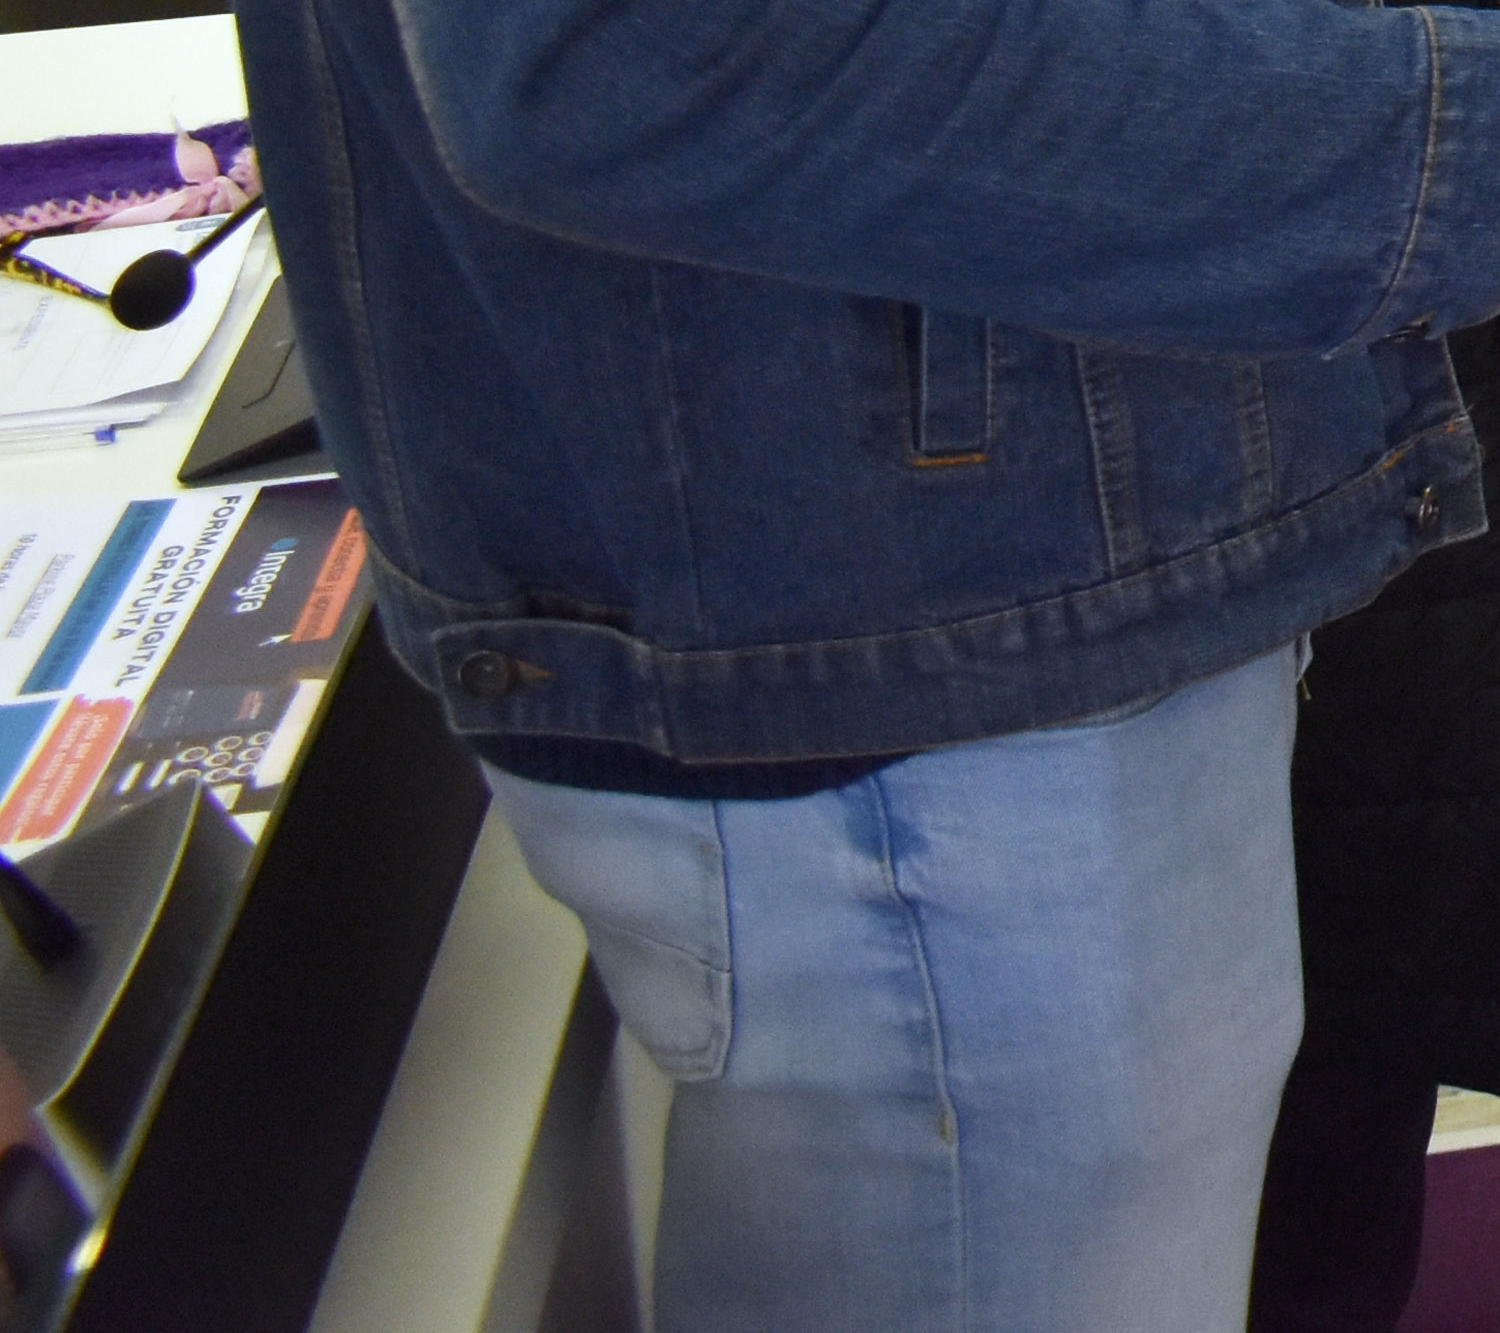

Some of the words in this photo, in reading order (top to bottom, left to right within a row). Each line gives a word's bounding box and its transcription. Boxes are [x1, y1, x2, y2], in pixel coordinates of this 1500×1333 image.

[111, 544, 186, 643] GRATUITA
[162, 494, 243, 605] FORMACIÓN
[234, 549, 296, 614] Integra
[114, 609, 178, 689] DIGITAL
